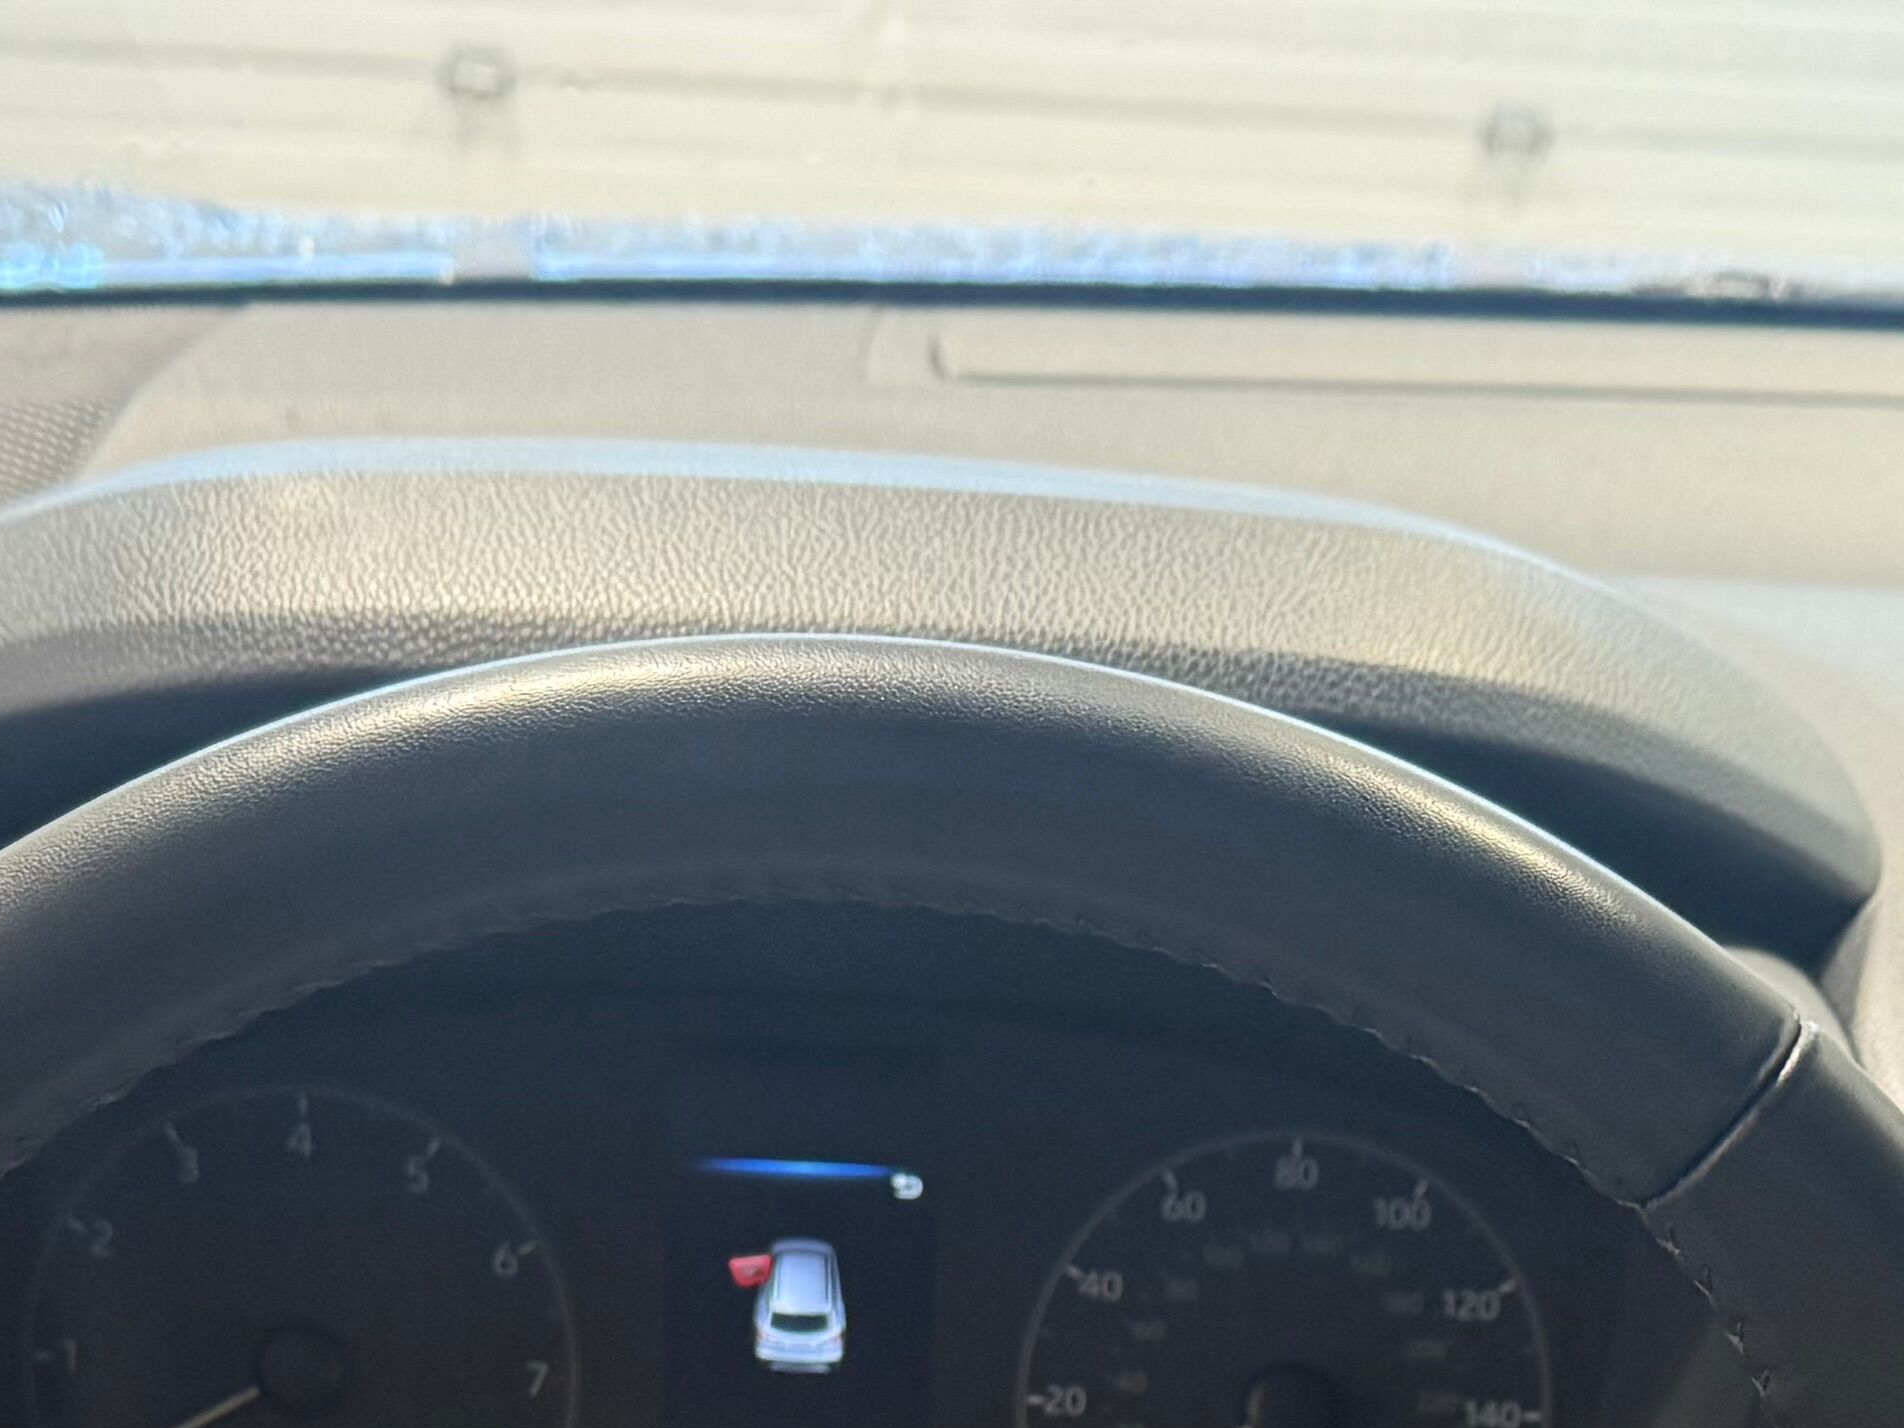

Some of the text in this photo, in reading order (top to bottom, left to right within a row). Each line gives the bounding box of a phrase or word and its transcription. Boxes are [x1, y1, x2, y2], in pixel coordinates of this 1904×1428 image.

[406, 1156, 429, 1193] 5
[1273, 1157, 1319, 1190] 80
[1161, 1192, 1206, 1223] 60
[1374, 1198, 1433, 1231] 100
[90, 1219, 115, 1258] 2
[493, 1242, 519, 1276] 6
[1076, 1269, 1124, 1301] 40
[1441, 1288, 1501, 1322] 120
[526, 1360, 550, 1398] 7
[1042, 1385, 1087, 1417] 20
